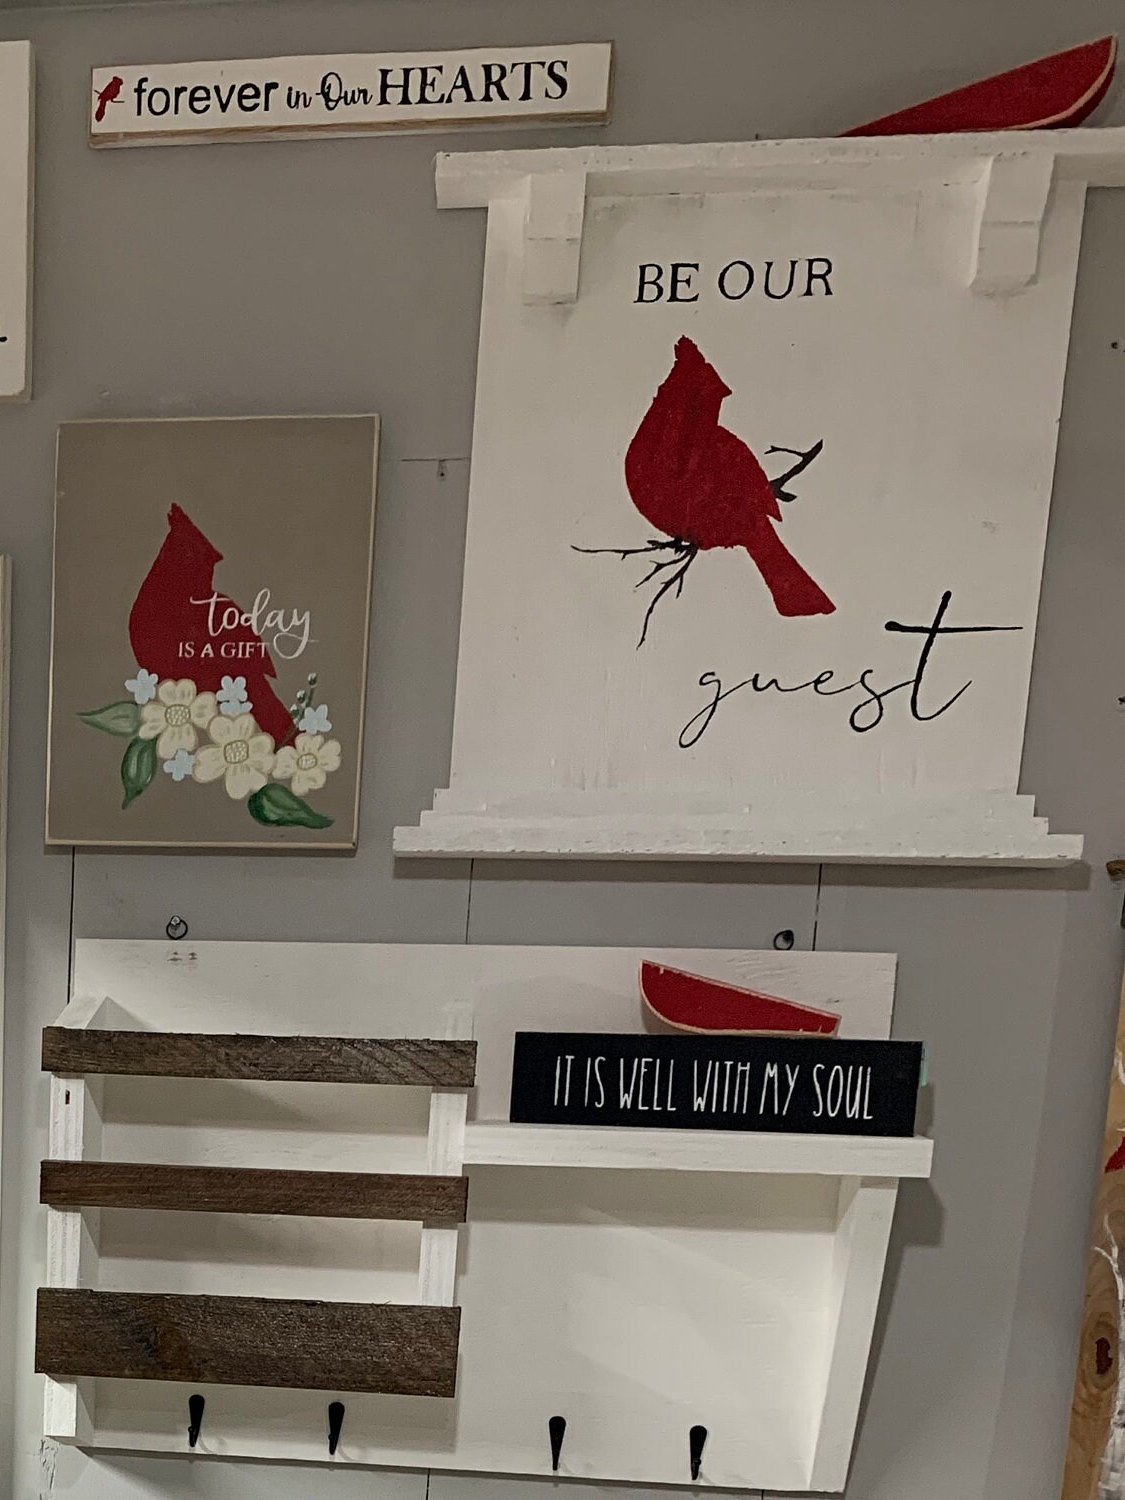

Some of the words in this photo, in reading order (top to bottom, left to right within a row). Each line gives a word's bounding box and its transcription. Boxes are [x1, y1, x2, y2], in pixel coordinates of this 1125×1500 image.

[133, 76, 279, 118] forever
[285, 85, 312, 110] in
[315, 72, 373, 112] Our
[376, 60, 569, 106] HEARTS
[633, 263, 700, 303] BE
[718, 257, 833, 300] OUR
[178, 641, 195, 658] IS
[200, 643, 214, 658] A
[220, 641, 270, 659] GIFT
[189, 588, 320, 660] today
[679, 590, 1023, 748] guest
[554, 1055, 574, 1106] IT
[584, 1056, 605, 1107] IS
[619, 1057, 677, 1111] WELL
[693, 1060, 751, 1115] WITH
[759, 1062, 800, 1116] MY
[812, 1063, 873, 1120] SOUL
